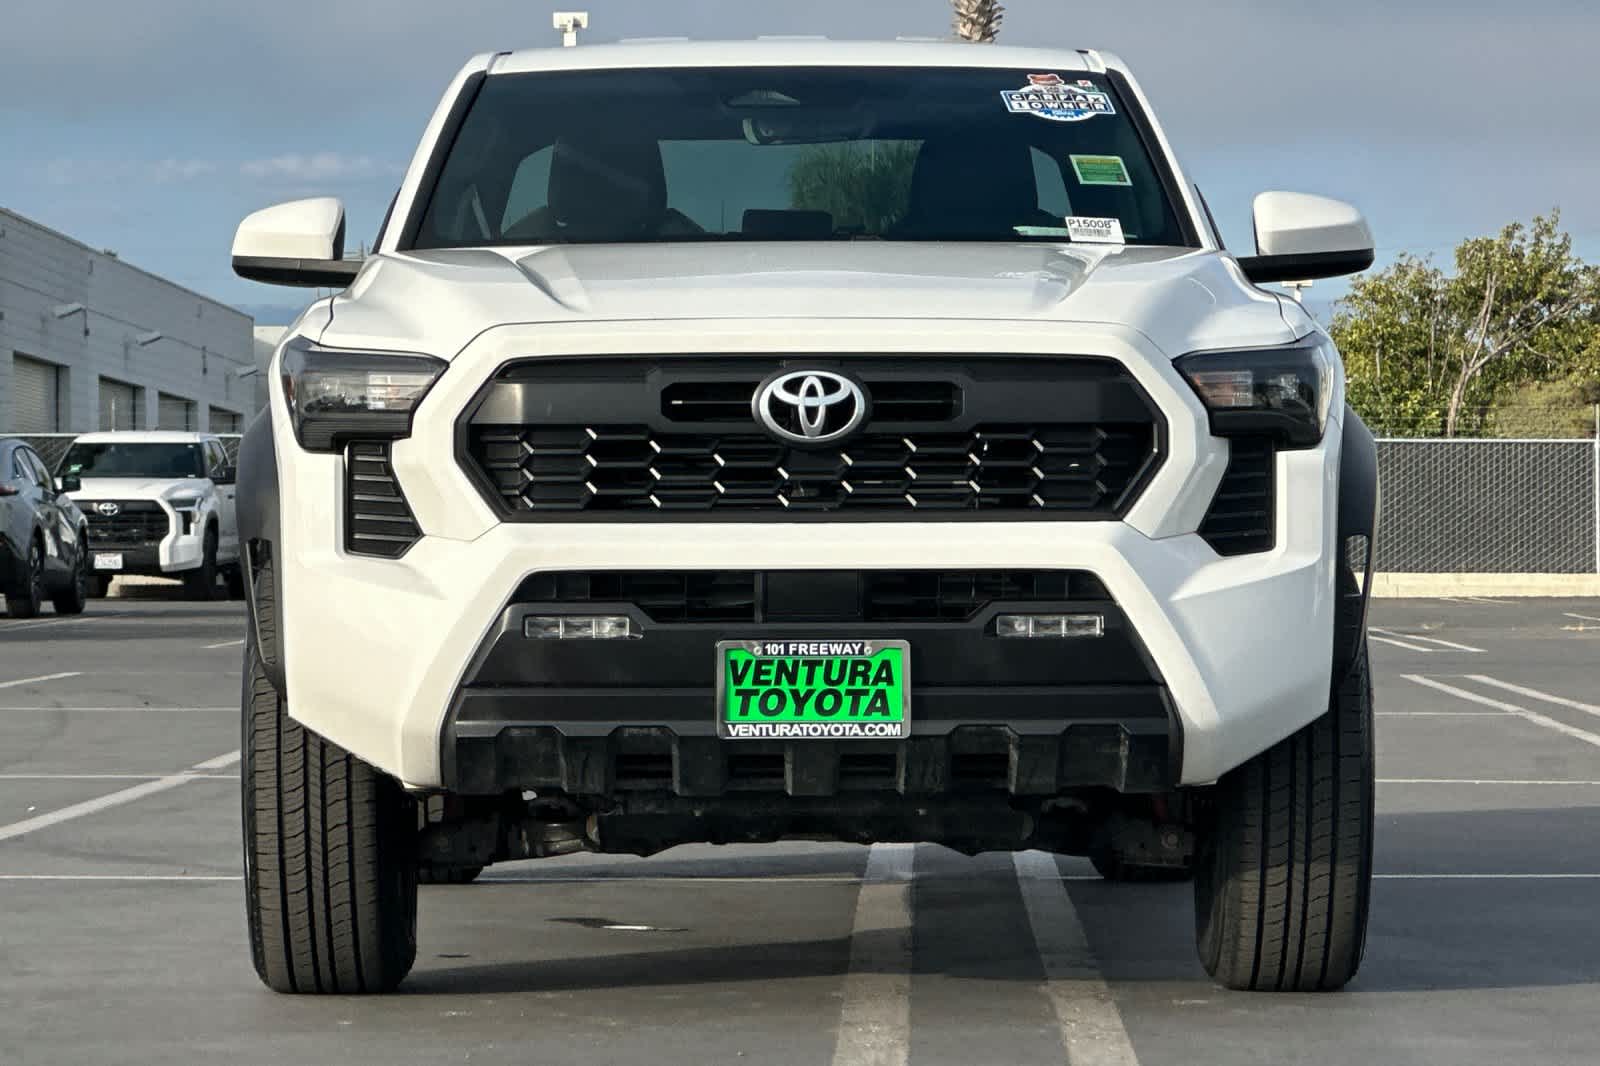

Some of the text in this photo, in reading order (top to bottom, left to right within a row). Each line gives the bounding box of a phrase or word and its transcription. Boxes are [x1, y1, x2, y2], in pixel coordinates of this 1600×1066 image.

[1011, 93, 1104, 103] CARFAX
[1030, 101, 1105, 111] OWNER
[765, 643, 861, 655] 101 FREEWAY
[729, 659, 894, 686] VENTURA
[735, 688, 891, 716] TOYOTA
[728, 724, 901, 736] VENTURATOYOTA.COM
